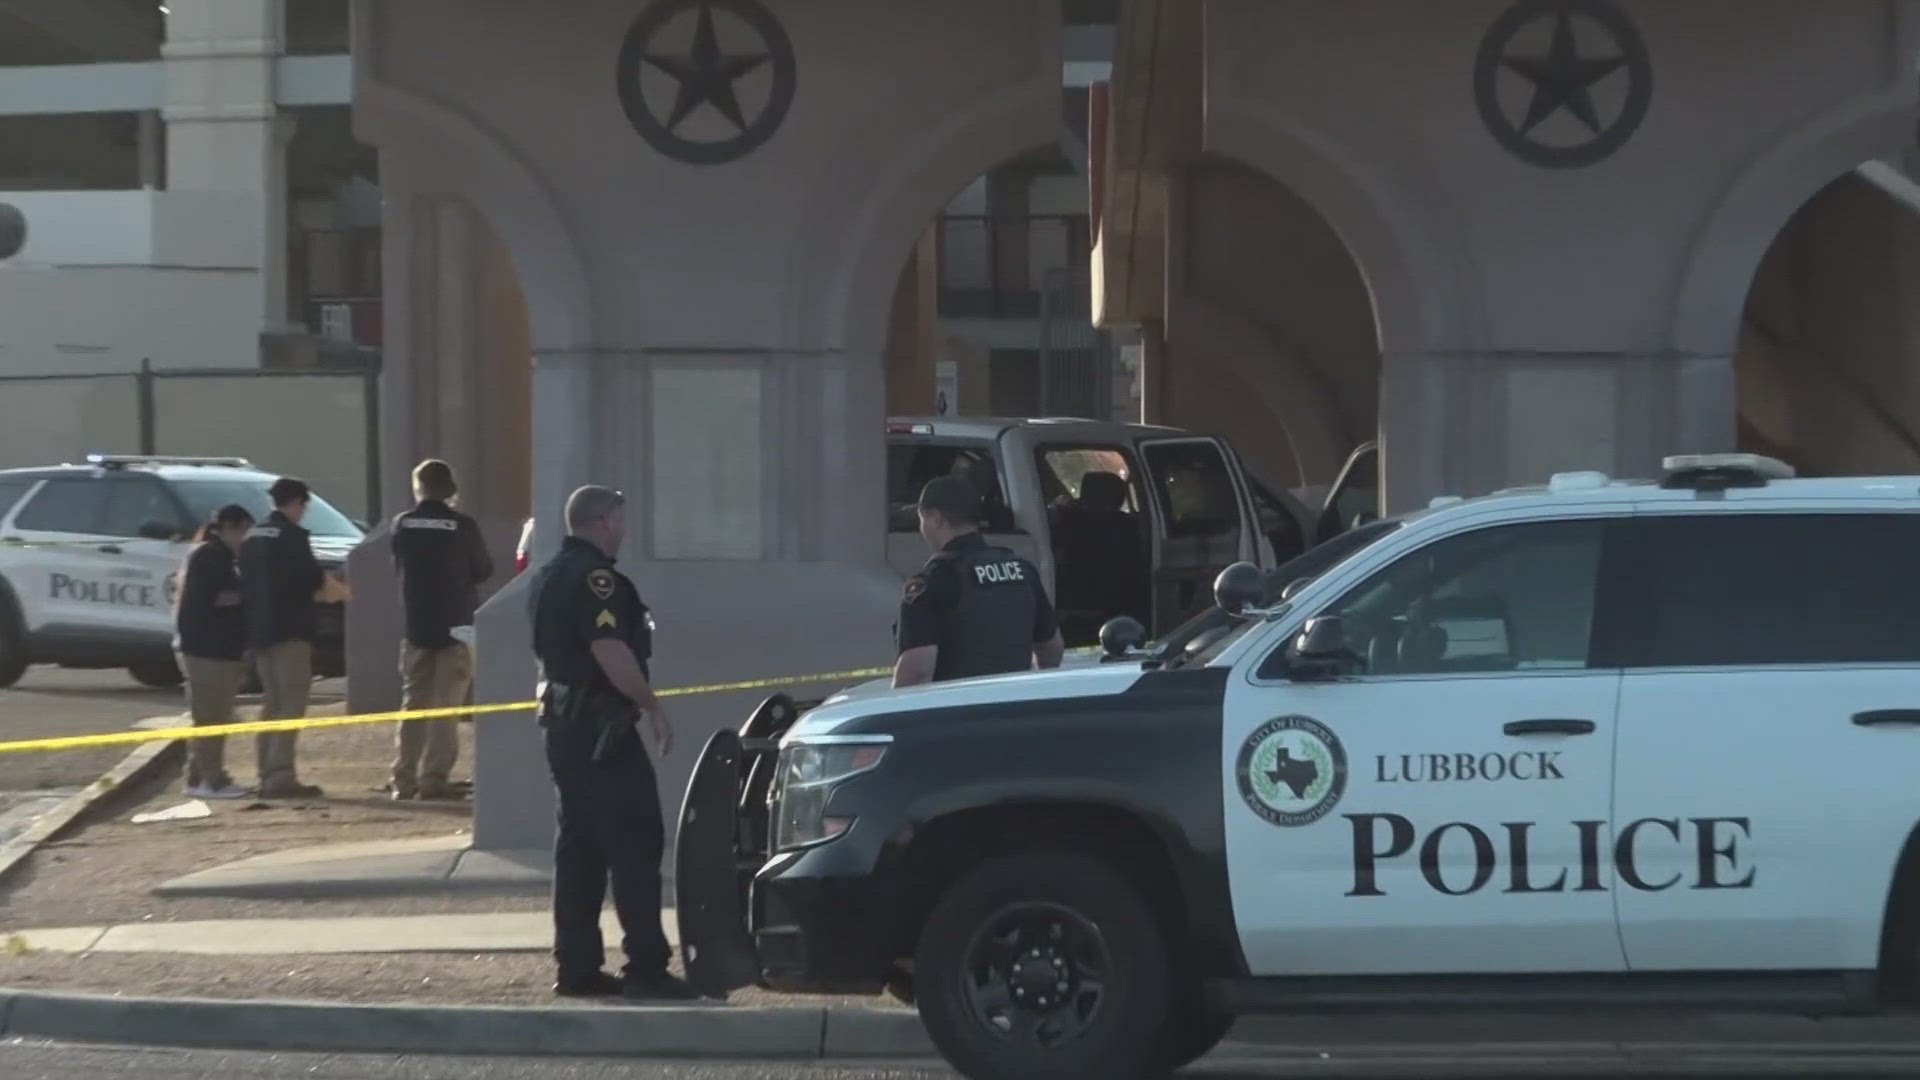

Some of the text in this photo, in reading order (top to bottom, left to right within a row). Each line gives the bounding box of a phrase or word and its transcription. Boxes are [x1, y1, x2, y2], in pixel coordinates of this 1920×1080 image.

[975, 561, 1024, 584] POLICE
[48, 572, 156, 607] POLICE
[1374, 751, 1566, 783] LUBBOCK
[1341, 812, 1757, 897] POLICE
